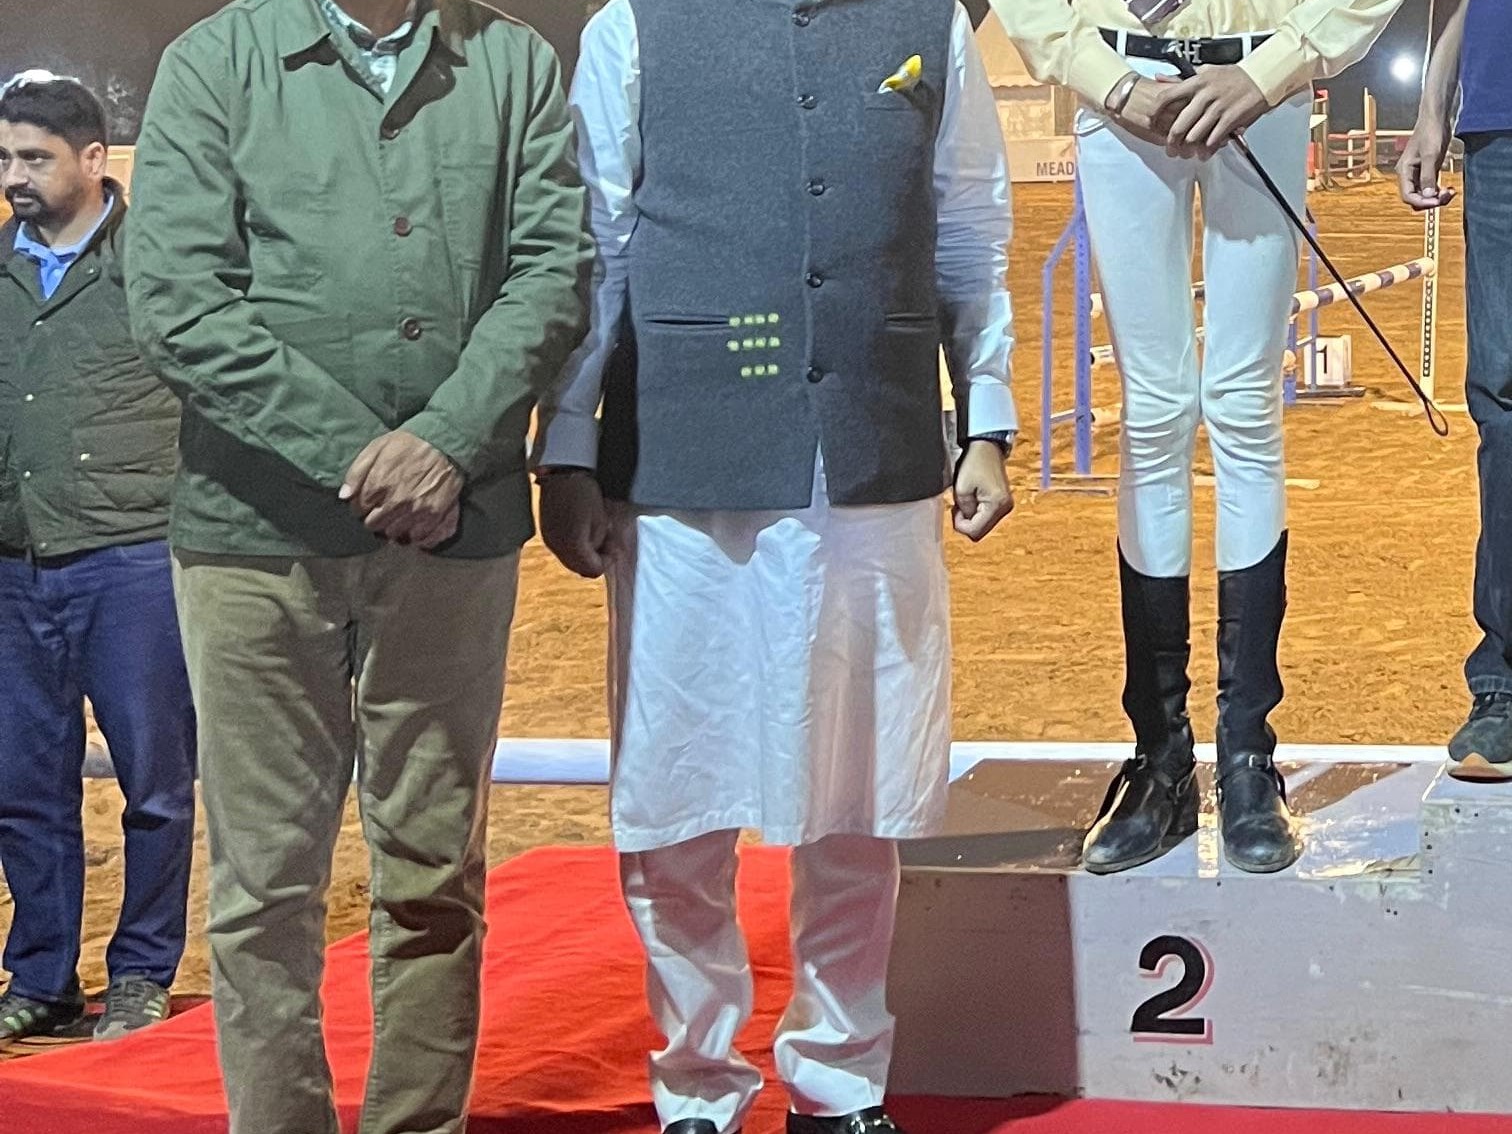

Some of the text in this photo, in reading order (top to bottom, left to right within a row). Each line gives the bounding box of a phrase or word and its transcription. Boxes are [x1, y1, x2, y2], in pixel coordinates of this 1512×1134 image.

[1036, 161, 1075, 177] MEAD
[1315, 344, 1328, 374] 1
[1130, 934, 1211, 1042] 2
